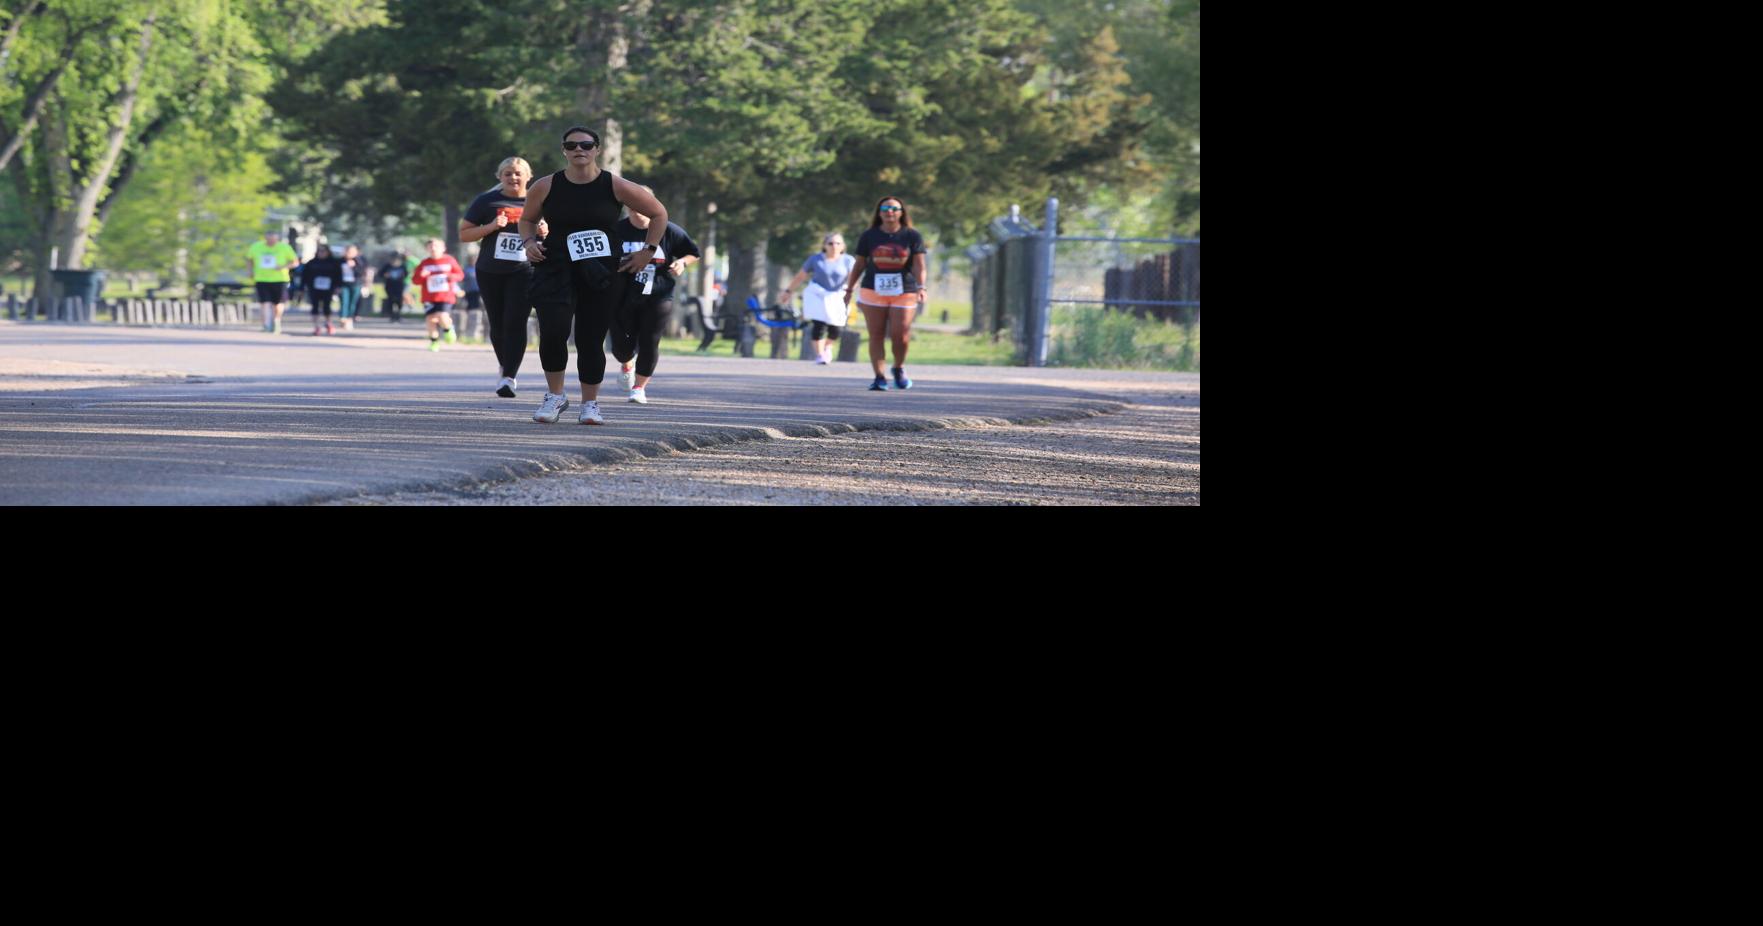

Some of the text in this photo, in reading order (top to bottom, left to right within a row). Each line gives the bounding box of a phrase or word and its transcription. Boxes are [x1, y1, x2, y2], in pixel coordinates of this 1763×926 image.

[501, 238, 524, 251] 462
[573, 236, 604, 254] 355
[879, 277, 899, 288] 335
